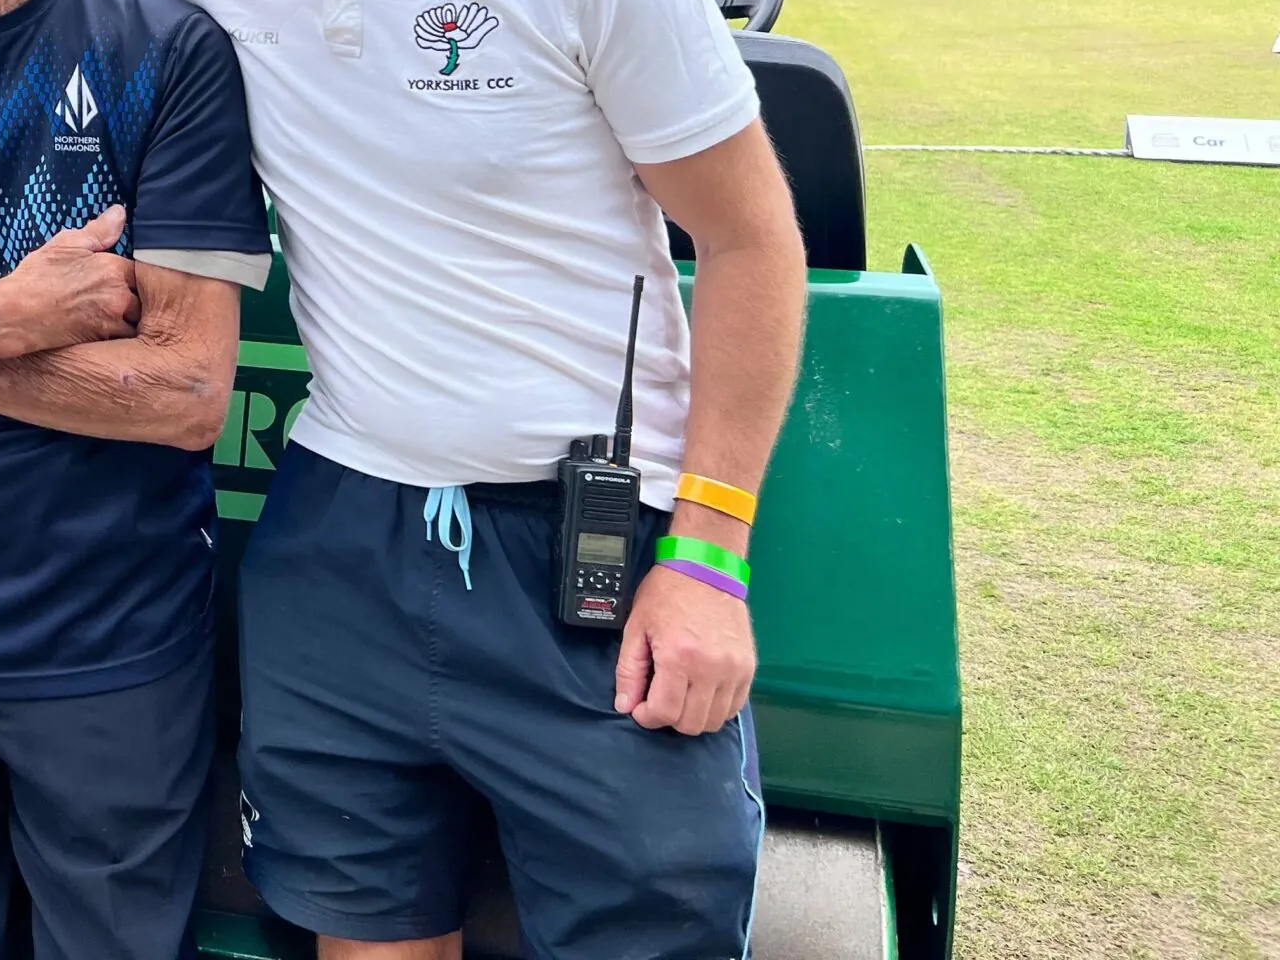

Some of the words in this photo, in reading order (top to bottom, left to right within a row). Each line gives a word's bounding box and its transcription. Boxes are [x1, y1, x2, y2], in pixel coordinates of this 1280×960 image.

[228, 27, 280, 45] KUKRI
[407, 78, 480, 92] YORKSHIRE
[487, 77, 515, 90] CCC
[54, 136, 100, 144] NORTHERN
[1192, 135, 1227, 147] Car
[54, 144, 100, 152] DIAMONDS
[594, 475, 631, 484] MOTOROLA
